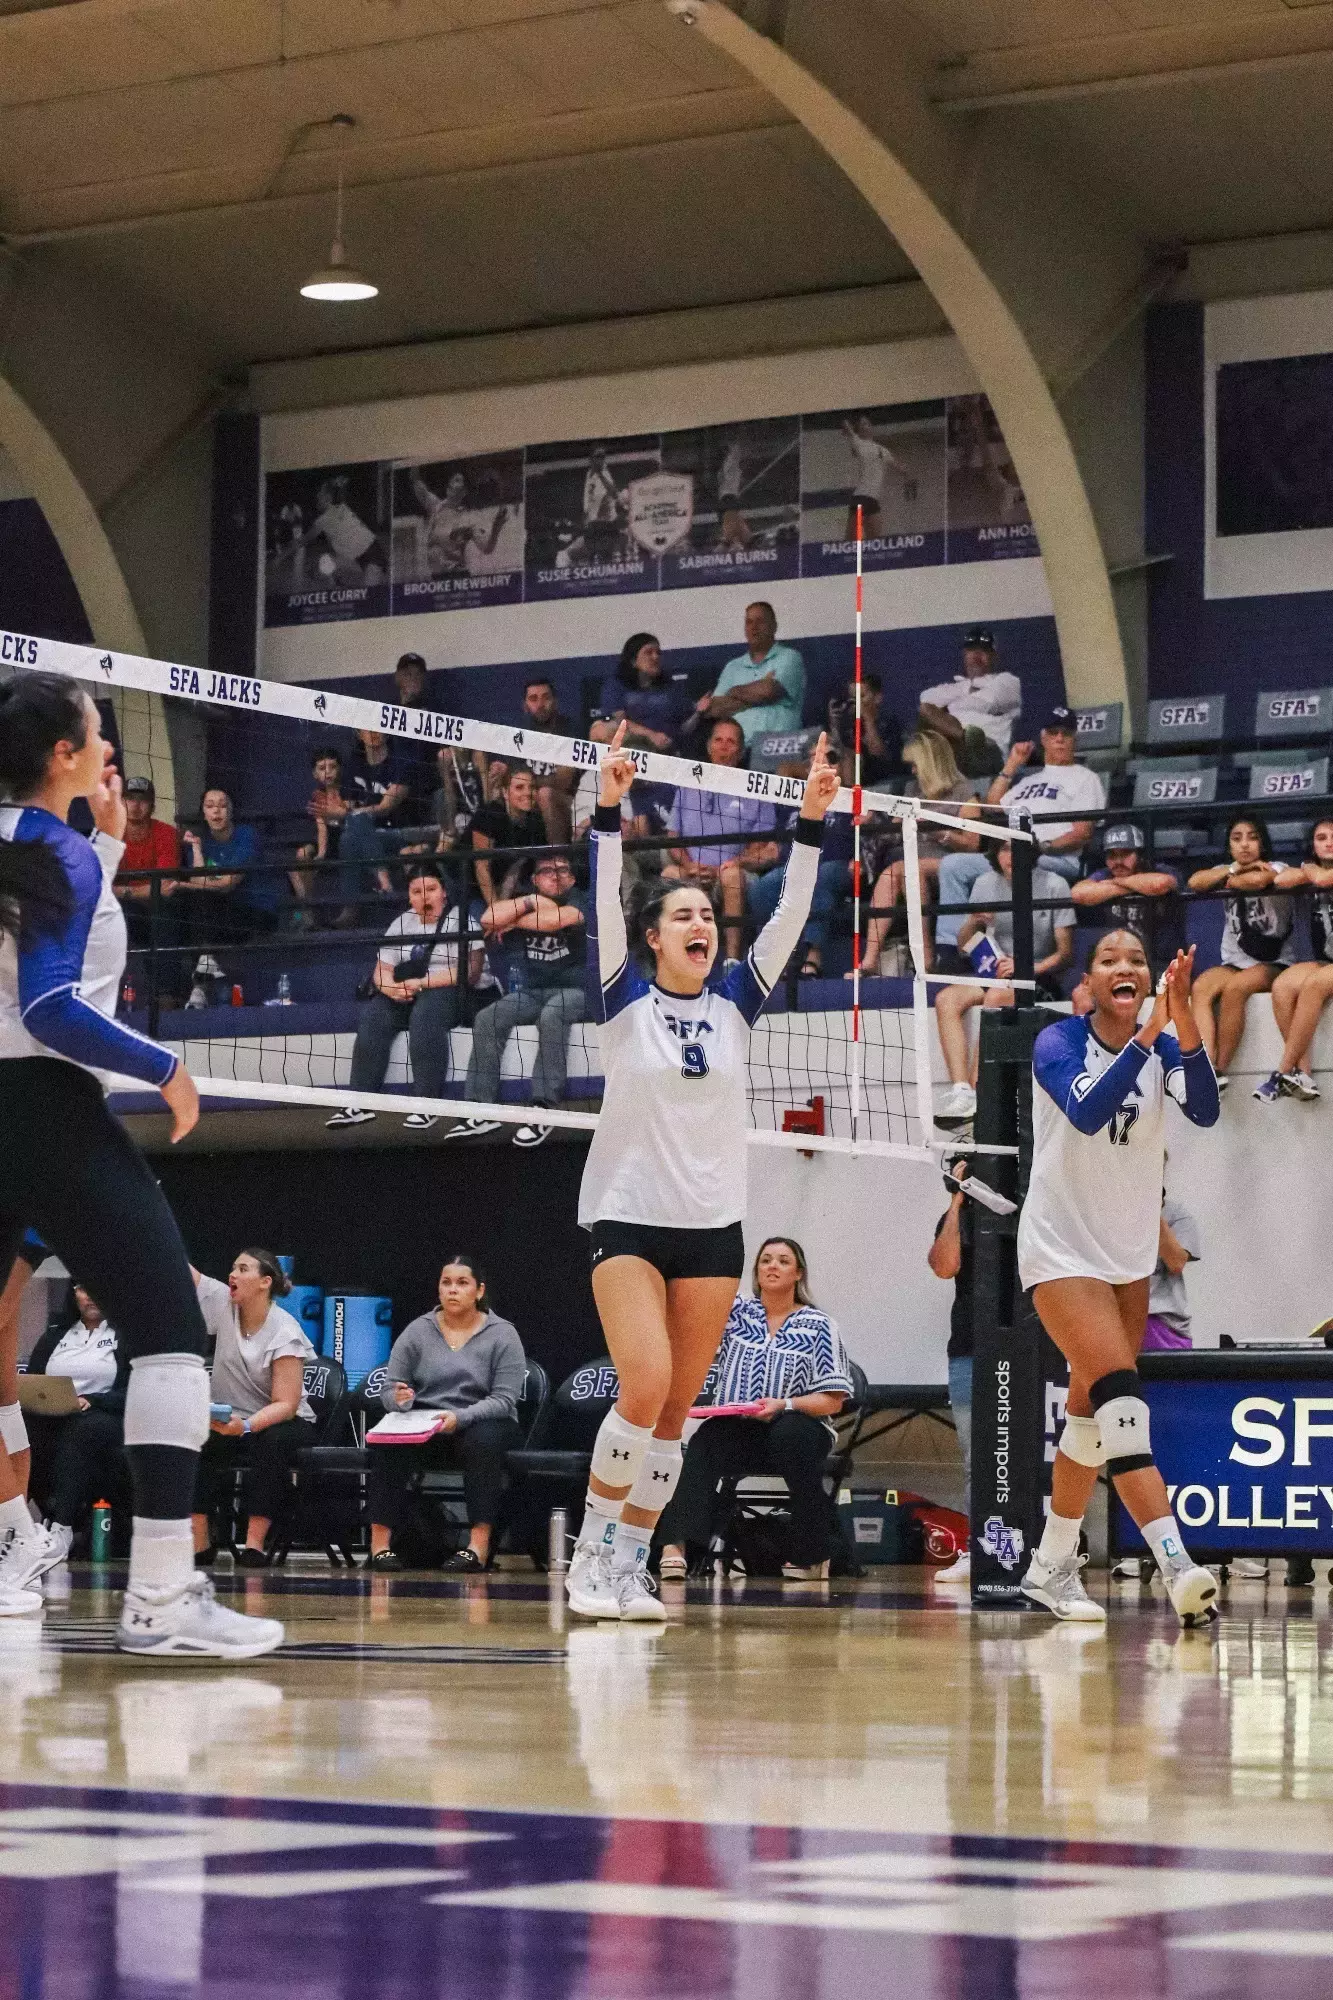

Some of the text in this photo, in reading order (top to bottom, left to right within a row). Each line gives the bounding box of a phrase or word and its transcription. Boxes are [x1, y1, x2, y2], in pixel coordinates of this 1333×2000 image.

[862, 535, 924, 552] HOLLAND
[979, 527, 1007, 541] ANN
[679, 553, 733, 570] SABRINA
[735, 549, 778, 565] BURNS
[538, 561, 645, 583] SUSIE SCHUMANN
[403, 574, 511, 596] BROOKE NEWBURY
[286, 588, 368, 608] JOYCEE CURRY
[169, 667, 262, 706] SFA JACKS
[1161, 707, 1197, 725] SFA
[1270, 699, 1306, 717] SFA
[380, 705, 464, 742] SFA JACKS
[572, 741, 598, 765] SFA
[747, 772, 770, 795] SFA
[1151, 781, 1188, 798] SFA
[1266, 775, 1301, 793] SFA
[681, 1043, 710, 1079] 9
[303, 1365, 331, 1398] FA
[993, 1360, 1012, 1503] sports imports
[984, 1516, 1019, 1562] SFA
